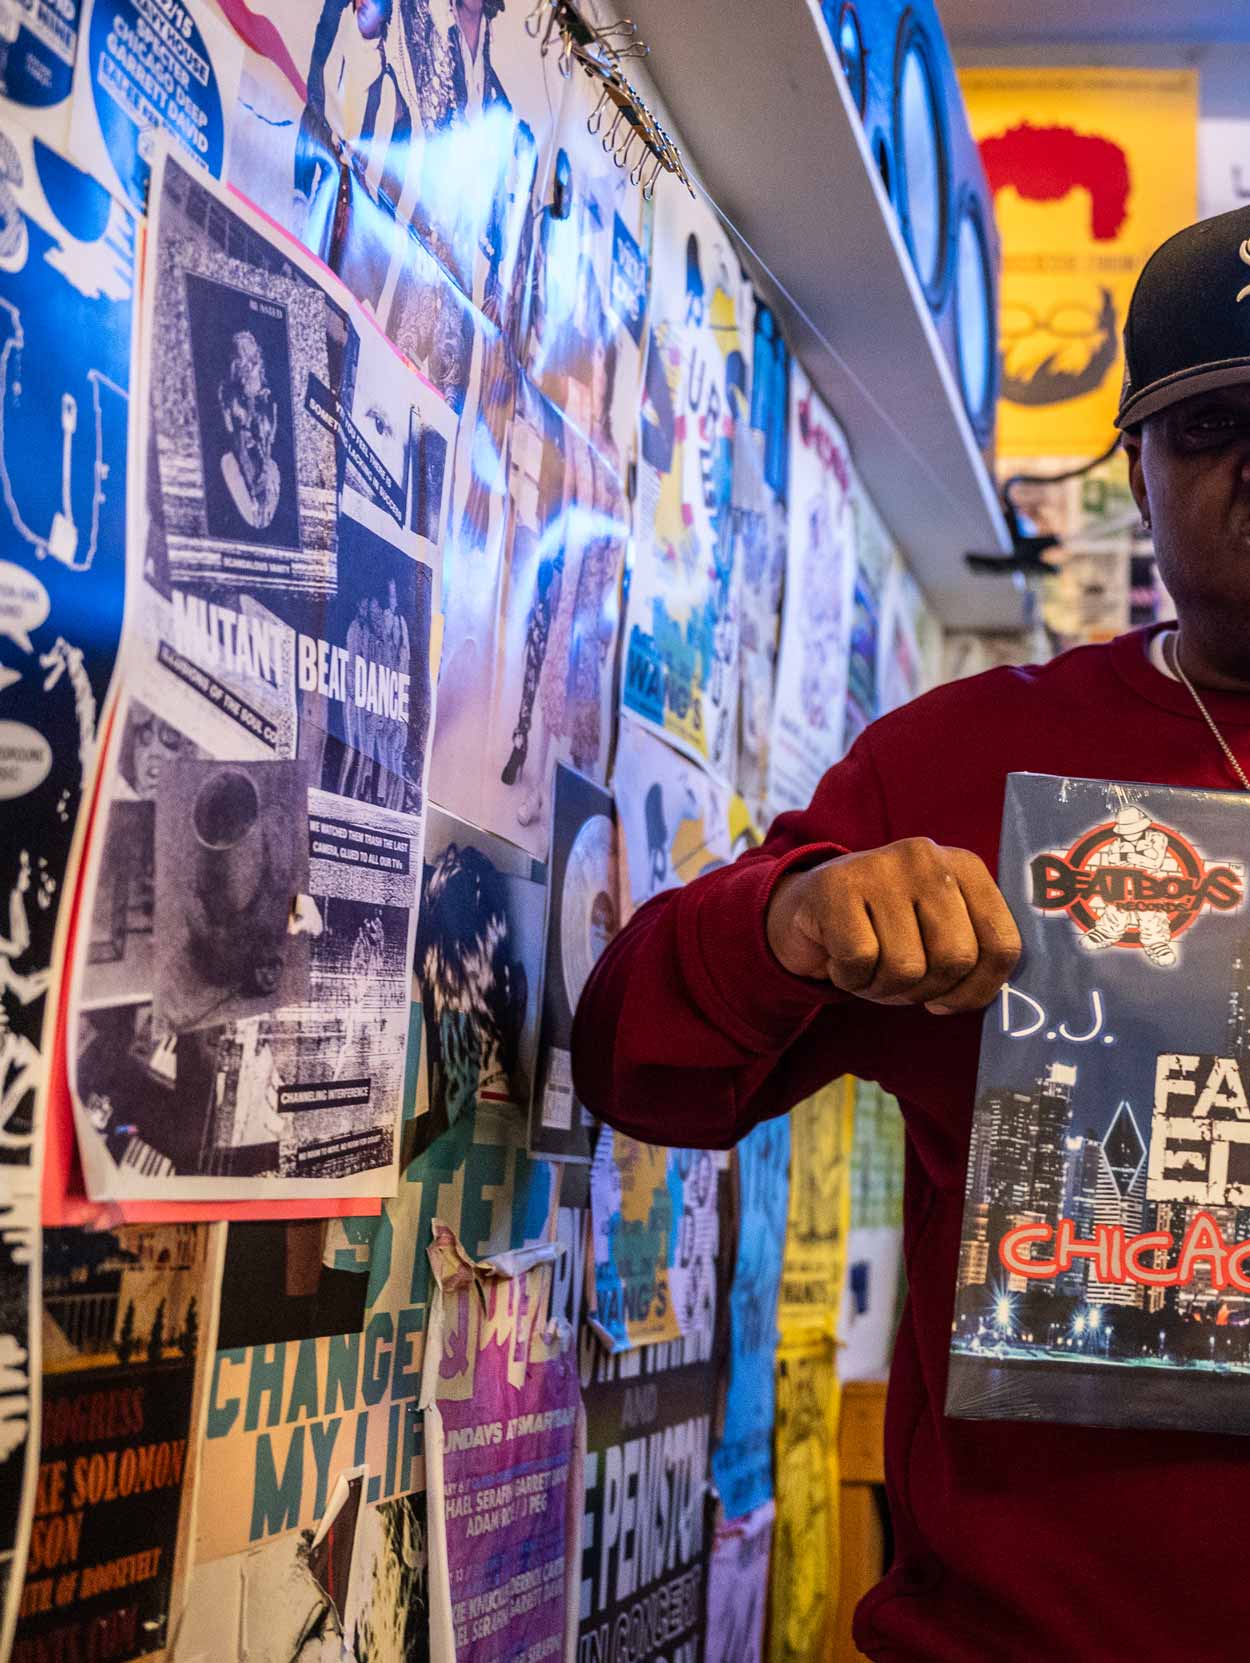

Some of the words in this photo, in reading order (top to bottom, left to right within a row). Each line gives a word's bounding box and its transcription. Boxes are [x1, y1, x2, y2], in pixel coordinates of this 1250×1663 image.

[106, 32, 168, 108] GARRETT
[112, 14, 173, 93] CHICAGO
[172, 588, 284, 690] MUTANT
[298, 633, 349, 703] BEAT
[352, 657, 412, 725] DANCE
[998, 982, 1116, 1045] D.J.
[206, 1308, 426, 1440] CHANGE
[70, 1438, 187, 1510] SOLOMON
[442, 1421, 504, 1455] UNDAYS
[249, 1417, 343, 1542] MY
